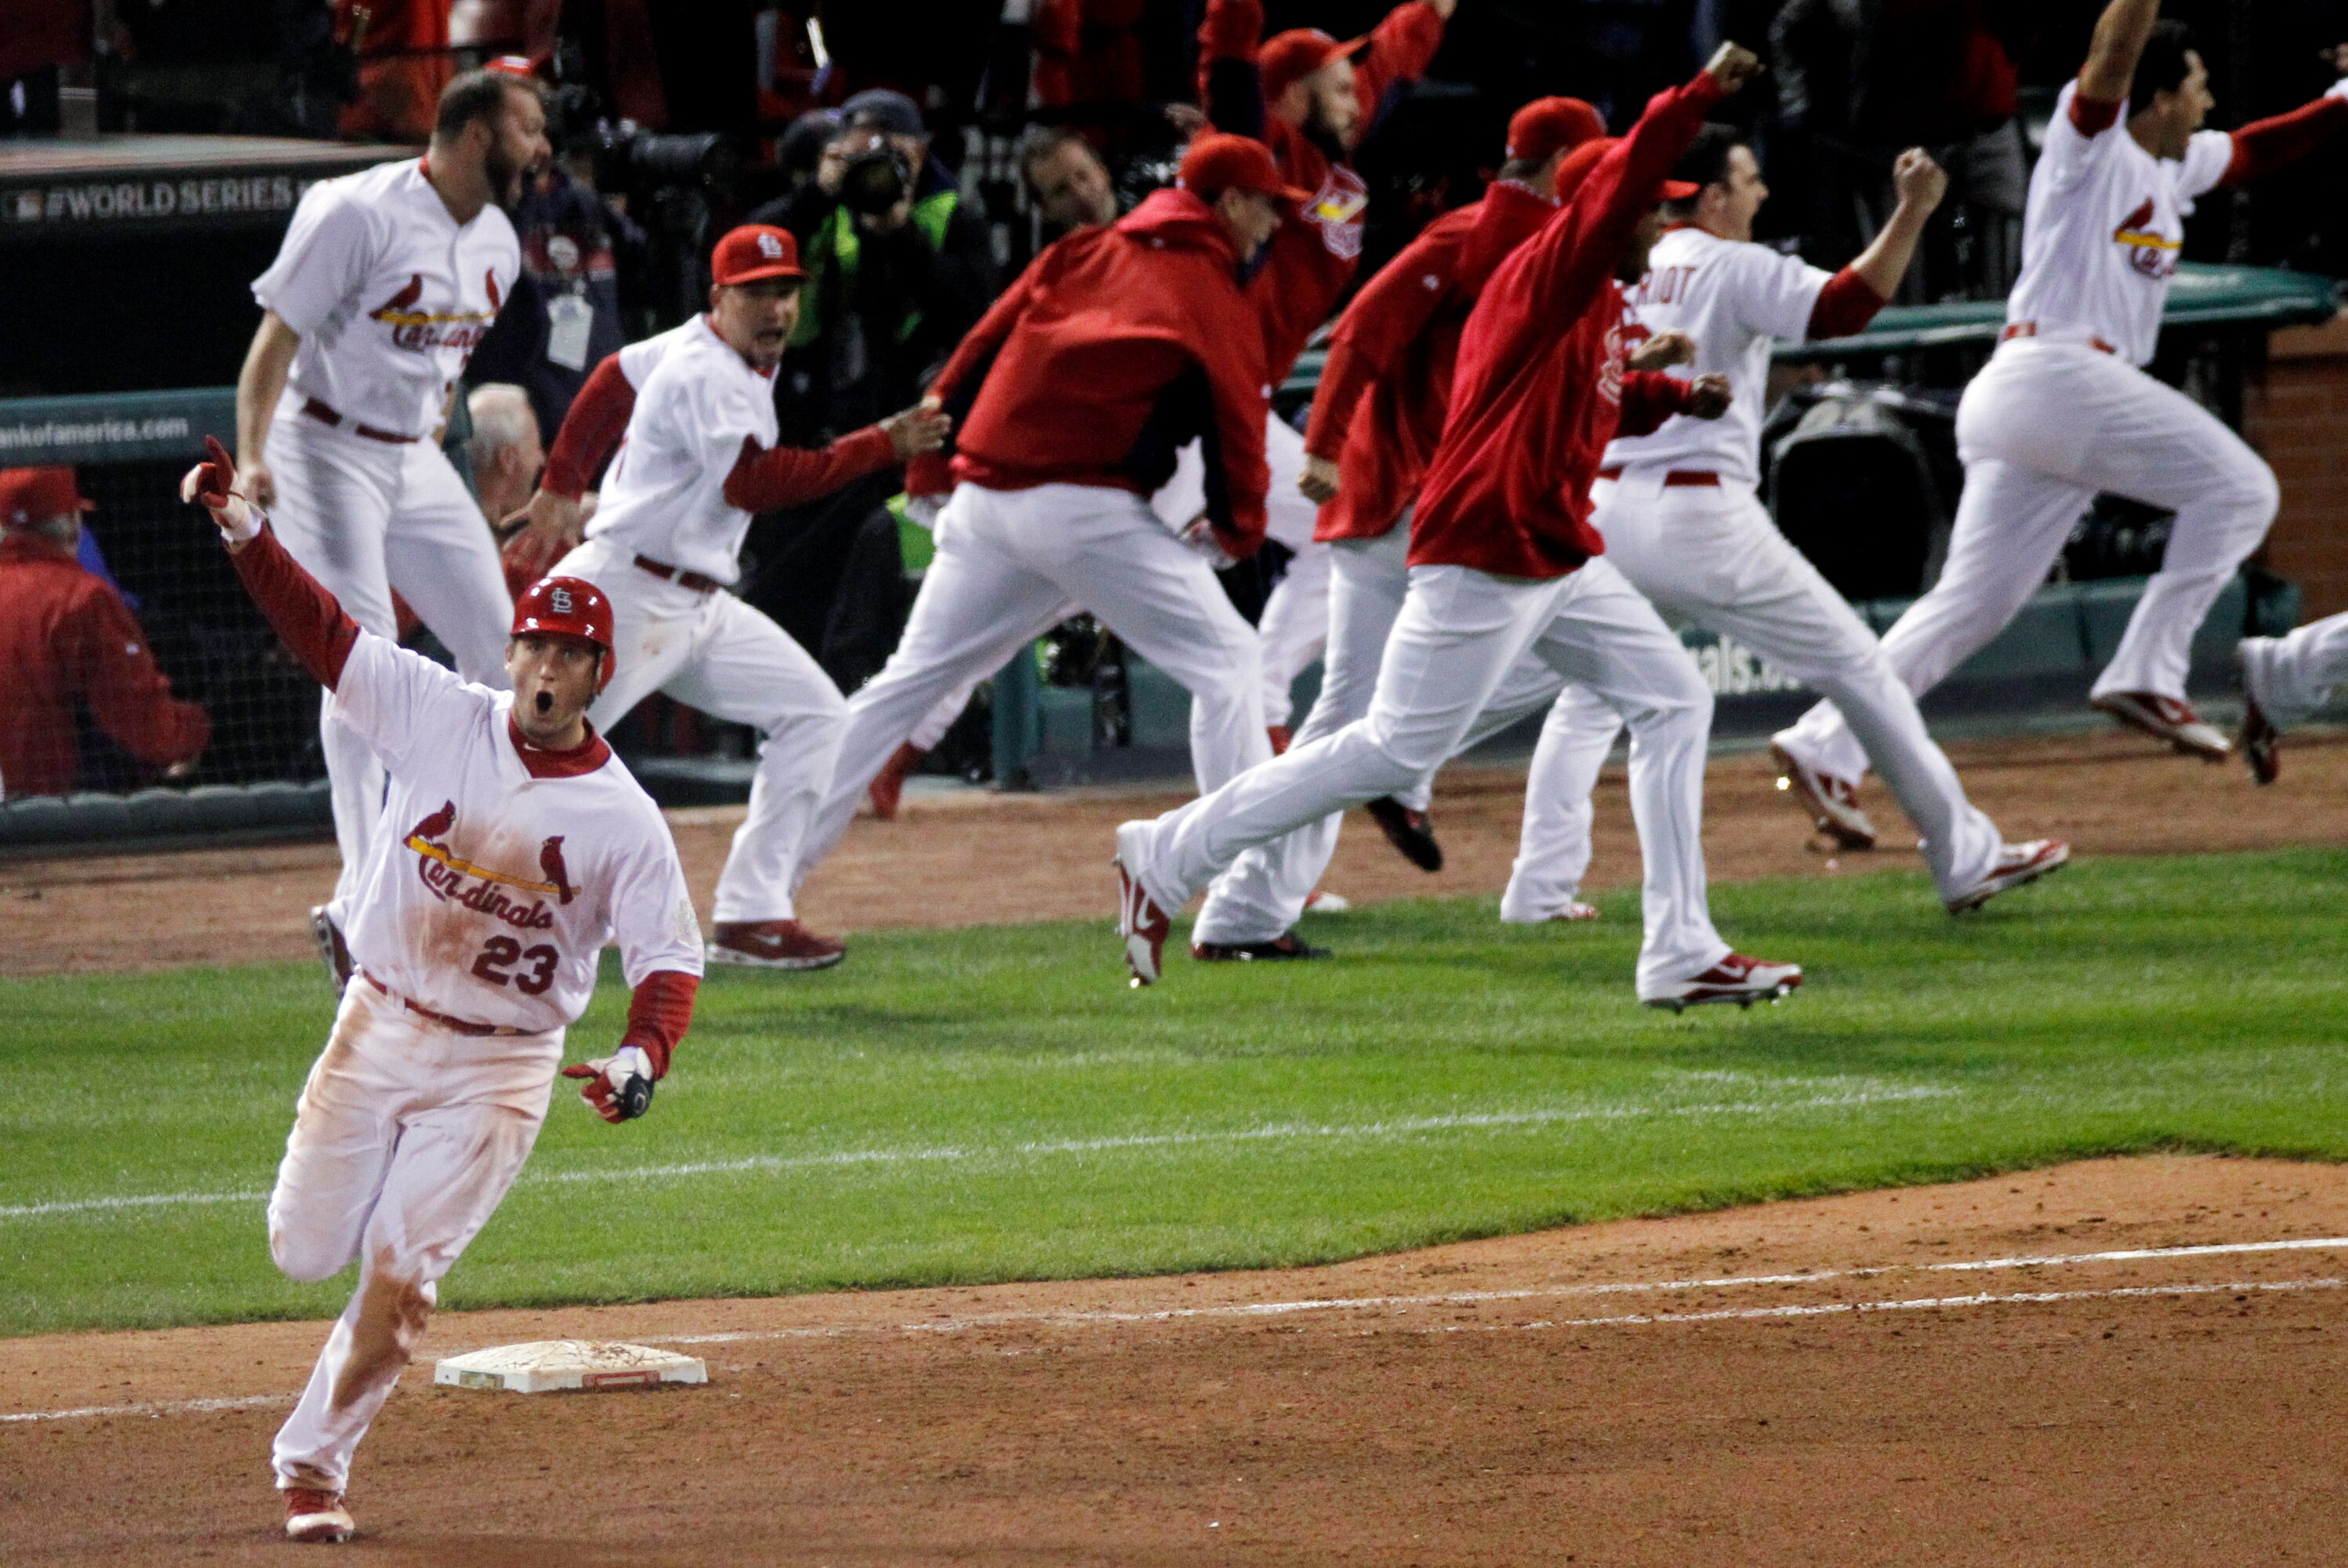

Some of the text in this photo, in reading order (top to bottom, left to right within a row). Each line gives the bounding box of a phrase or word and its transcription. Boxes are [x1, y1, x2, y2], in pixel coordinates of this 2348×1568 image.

[179, 175, 292, 214] SERIES
[419, 842, 553, 929] Cardinals
[472, 935, 560, 995] 23
